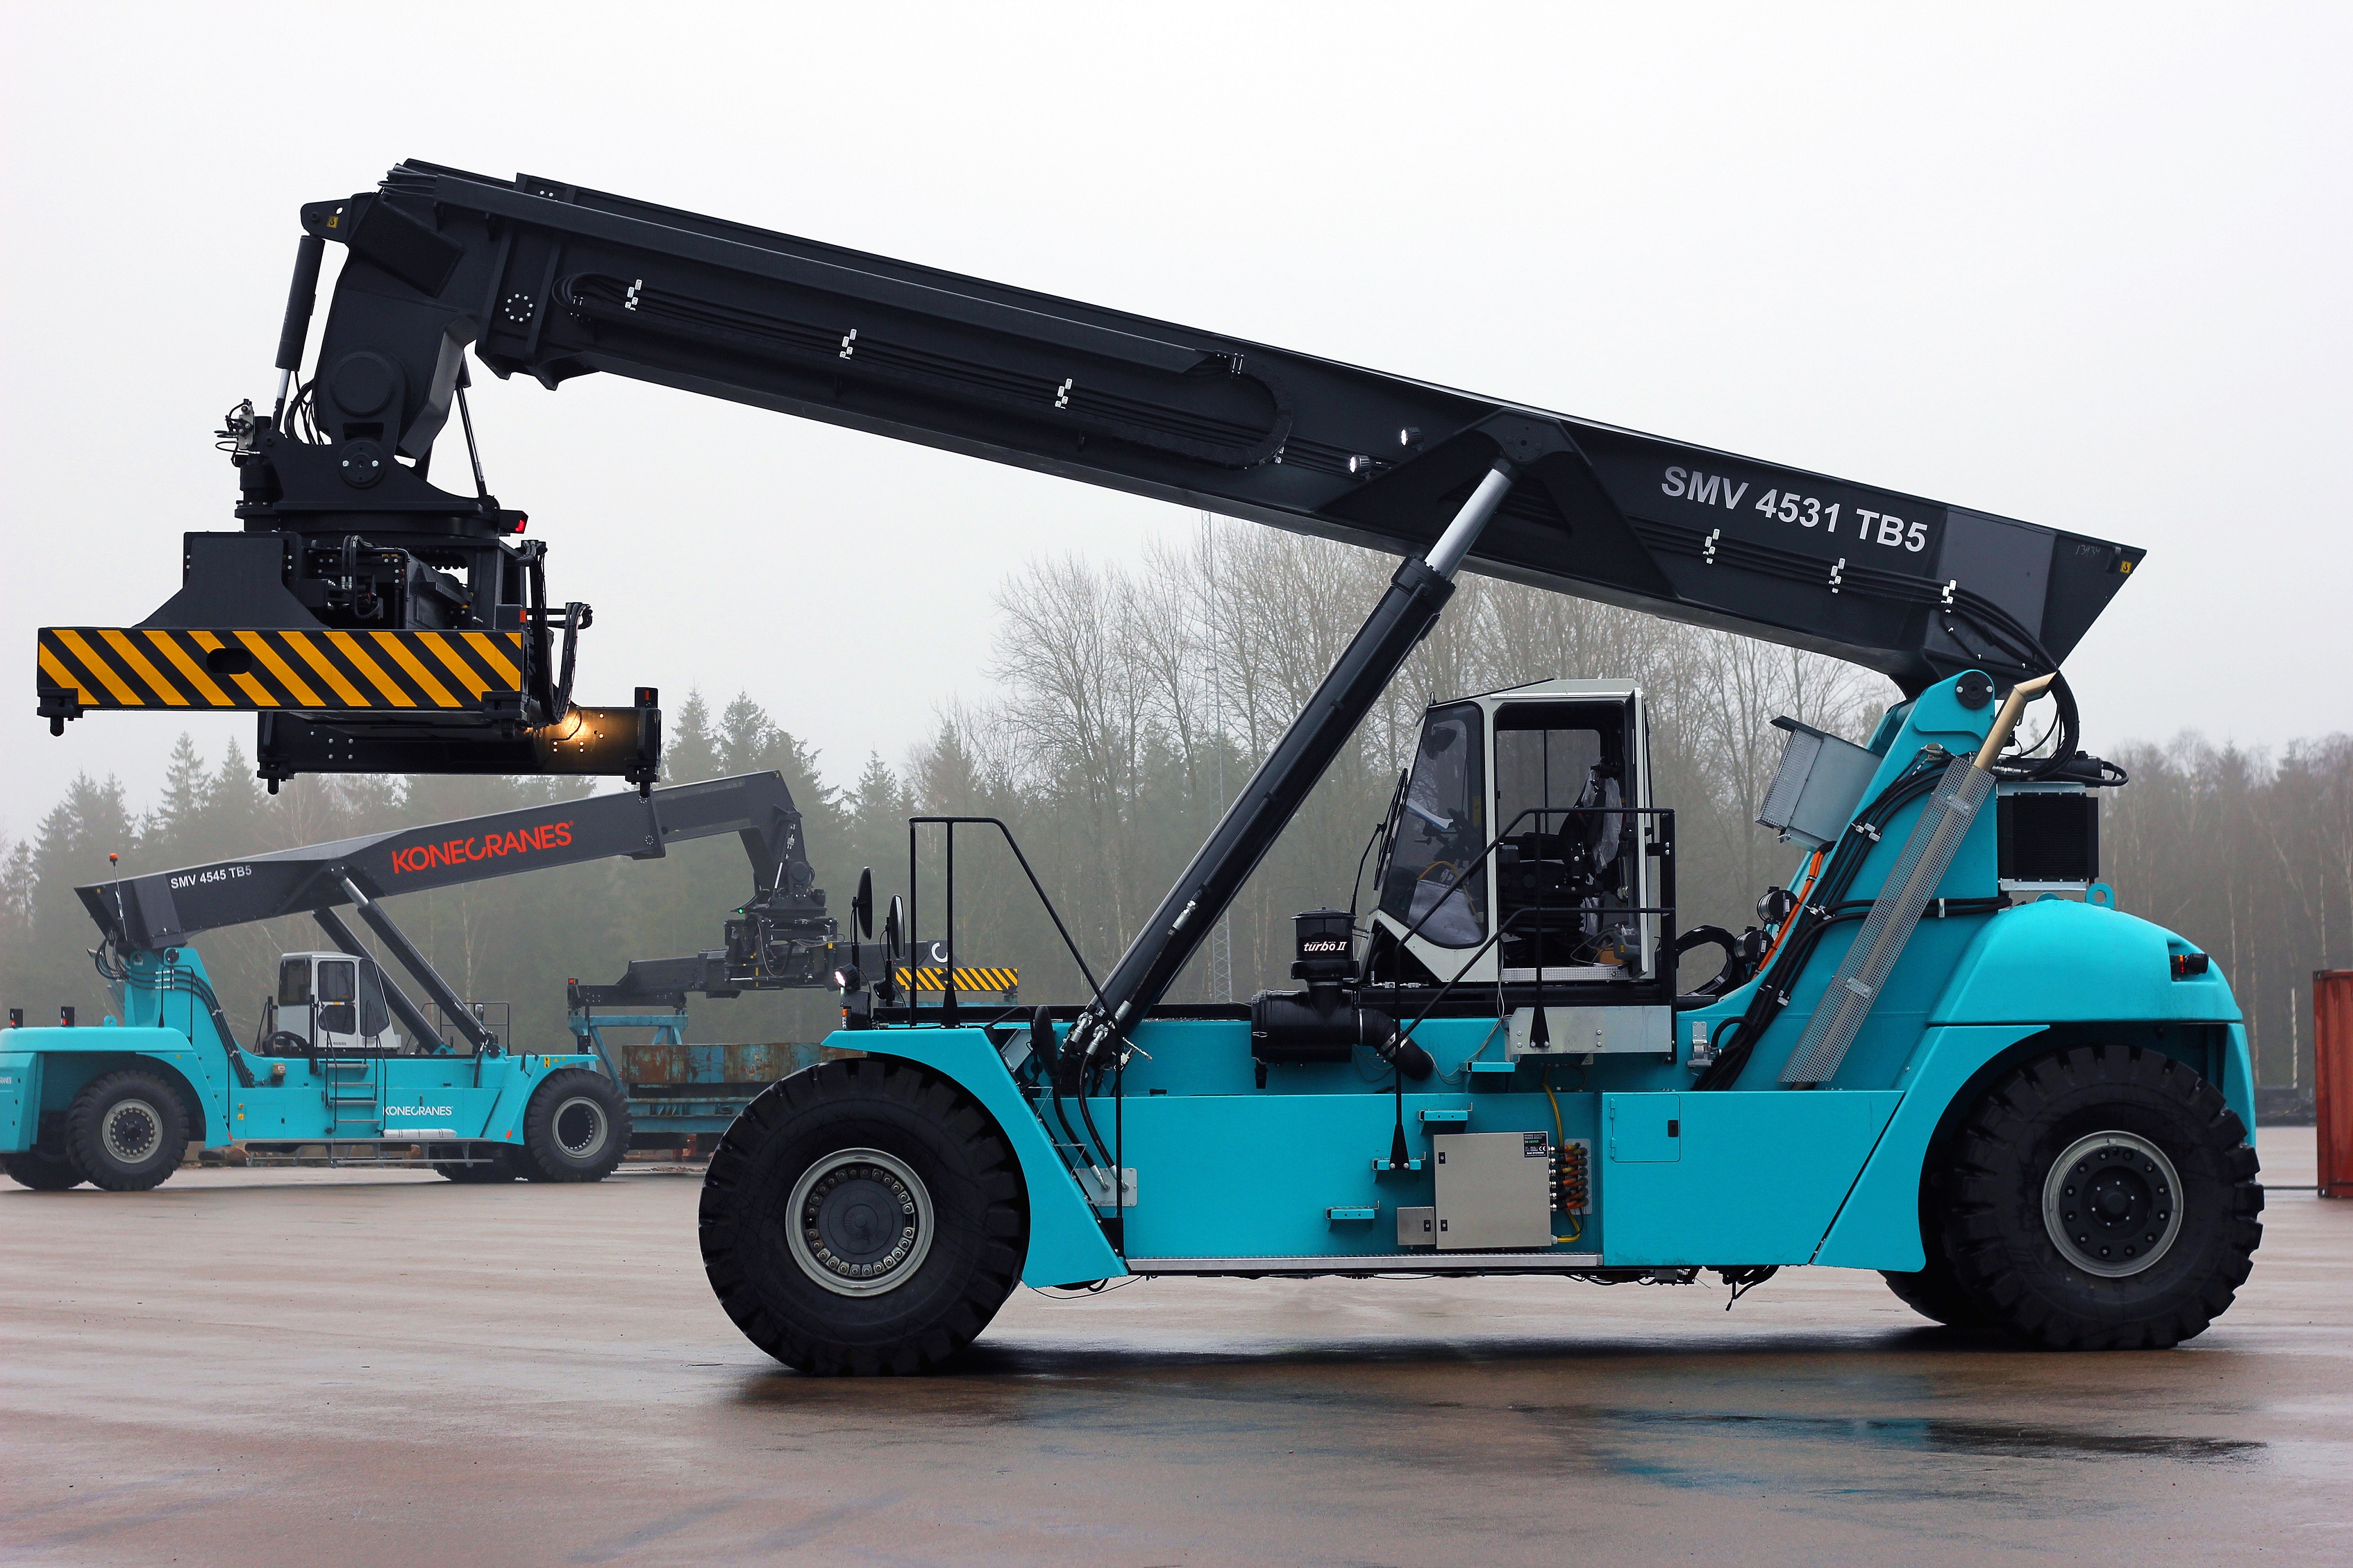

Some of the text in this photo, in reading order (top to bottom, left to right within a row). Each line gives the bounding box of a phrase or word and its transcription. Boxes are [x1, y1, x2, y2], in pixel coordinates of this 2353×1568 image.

[1662, 466, 1928, 552] SMV 4531 TB5
[170, 865, 252, 889] SMV 4545 TB5
[1304, 941, 1336, 952] turbo
